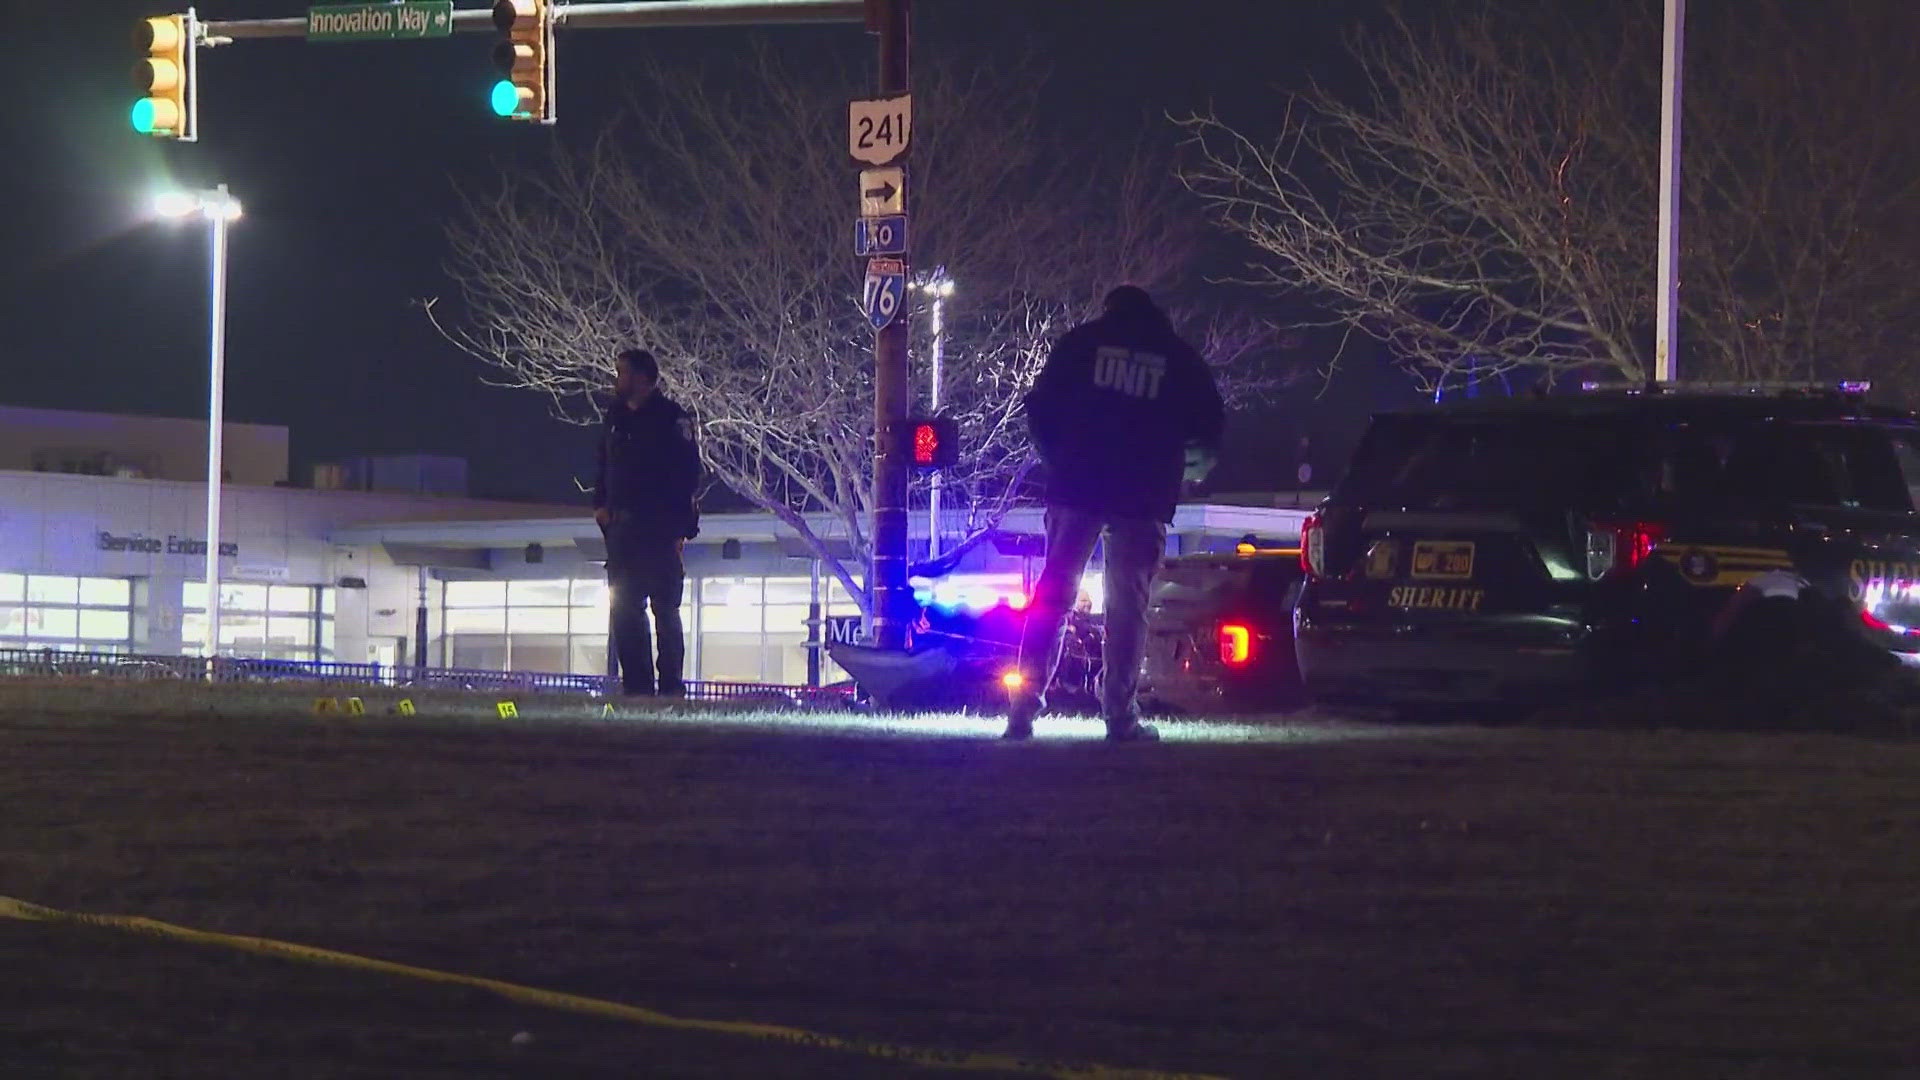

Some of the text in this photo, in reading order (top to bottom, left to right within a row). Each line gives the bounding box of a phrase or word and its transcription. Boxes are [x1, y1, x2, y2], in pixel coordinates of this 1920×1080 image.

[309, 6, 430, 37] Innovation Way
[858, 113, 904, 150] 241
[867, 276, 896, 316] 76
[1094, 356, 1166, 399] UNIT
[98, 531, 162, 554] Service
[1388, 586, 1485, 611] SHERIFF
